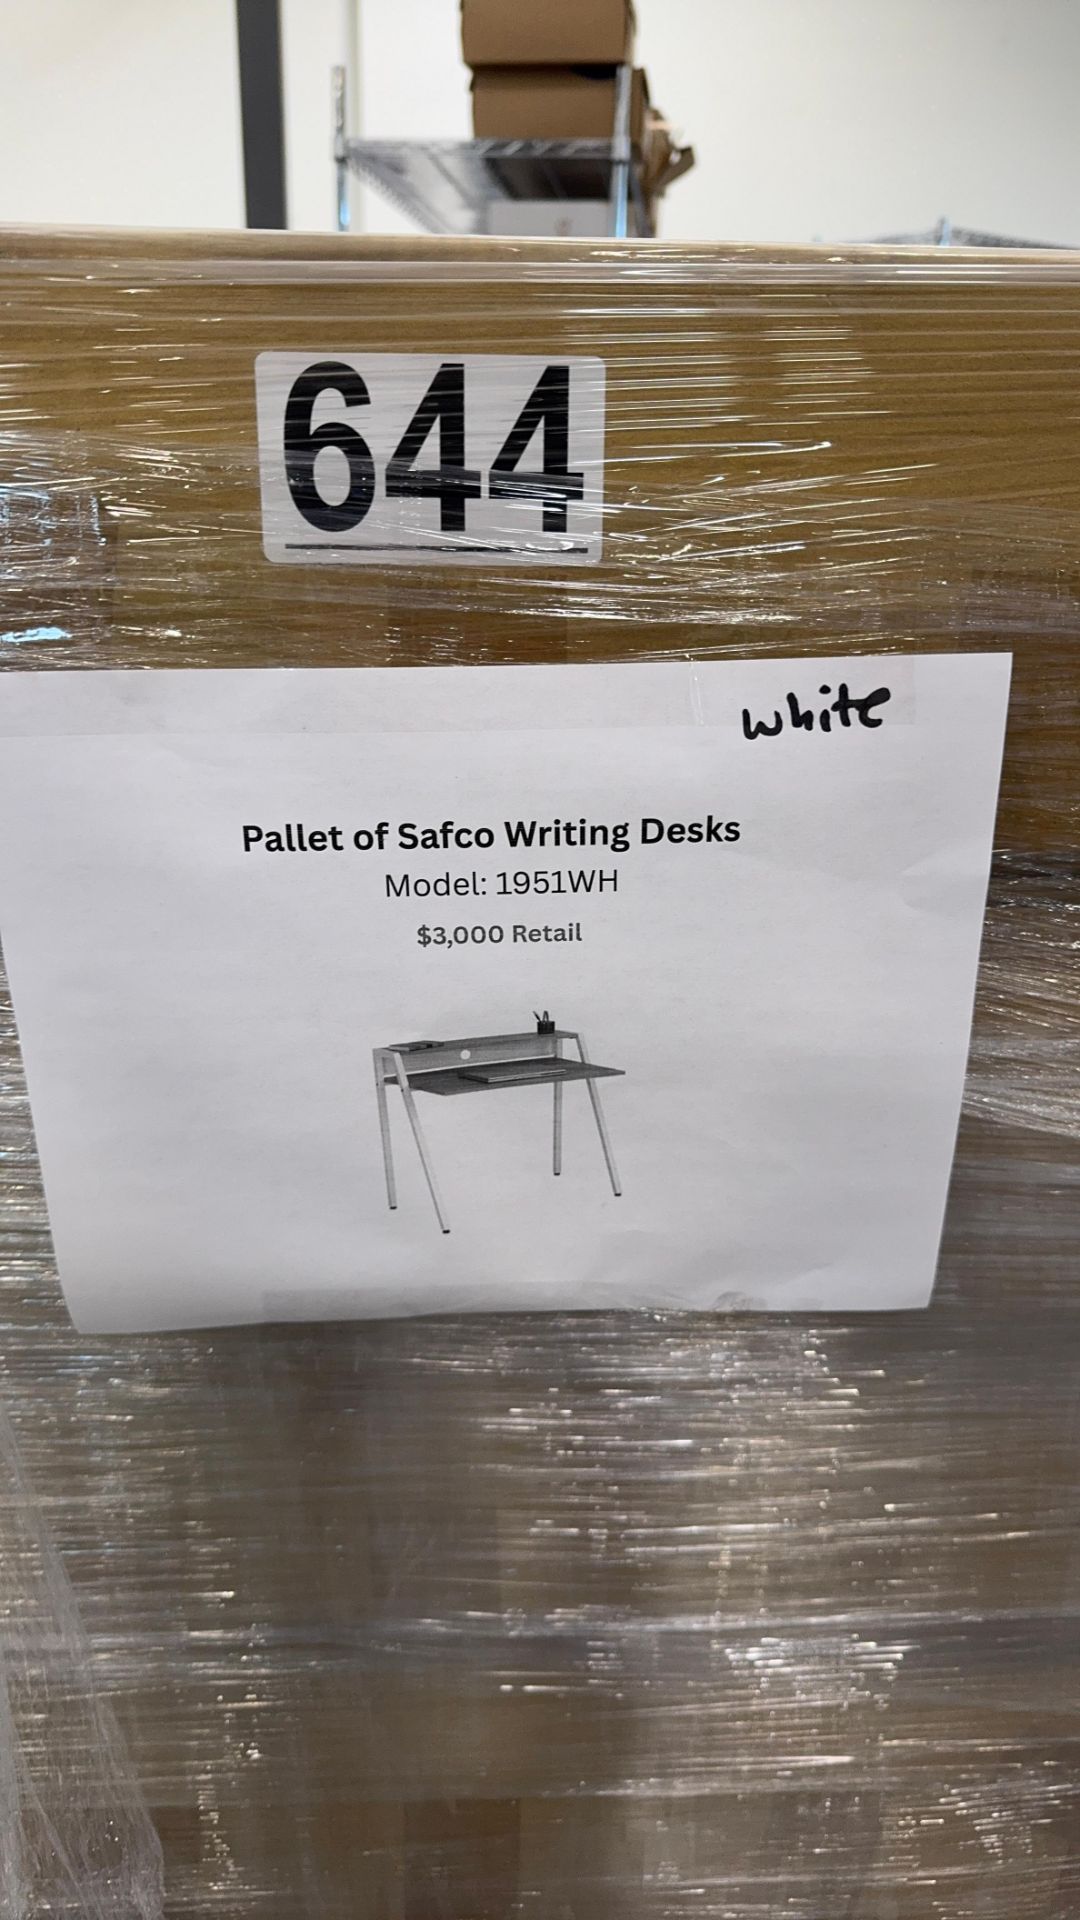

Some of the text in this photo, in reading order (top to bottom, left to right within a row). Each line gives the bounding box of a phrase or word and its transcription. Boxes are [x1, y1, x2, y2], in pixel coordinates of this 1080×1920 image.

[284, 362, 584, 533] 644
[243, 815, 740, 852] Pallet of Safco Writing Desks
[386, 869, 618, 898] Model: 1951WH
[417, 922, 582, 948] $3,000 Retail
